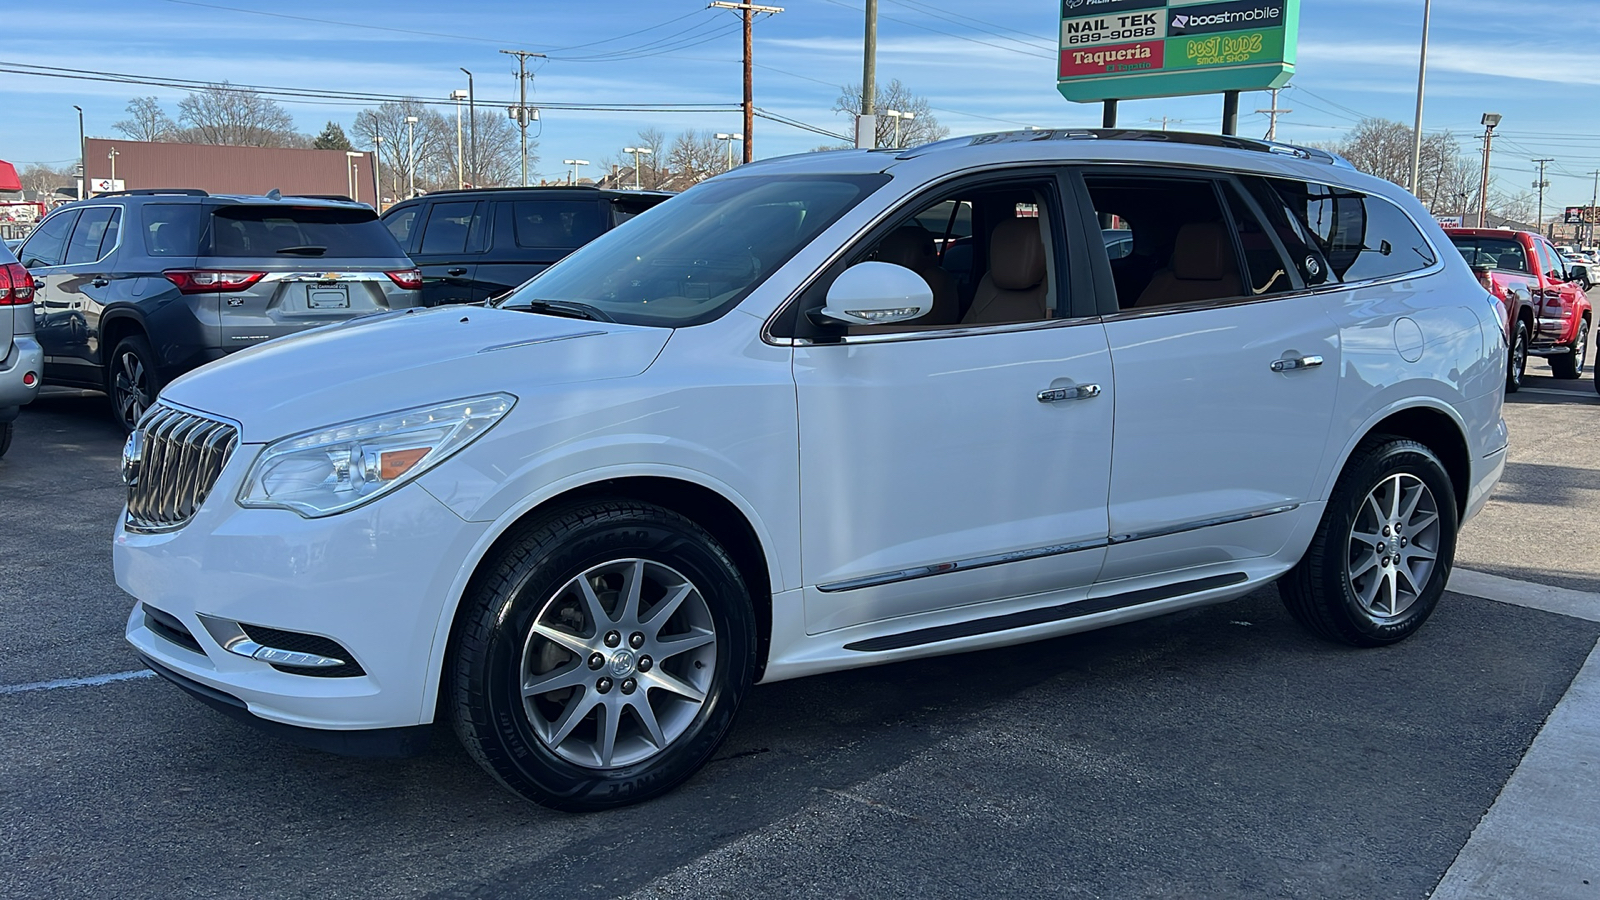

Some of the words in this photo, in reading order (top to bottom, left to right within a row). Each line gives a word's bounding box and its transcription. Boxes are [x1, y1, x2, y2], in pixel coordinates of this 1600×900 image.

[1067, 19, 1109, 34] NAIL
[1117, 12, 1157, 28] TEK
[1069, 26, 1156, 44] 689-9088
[1197, 56, 1225, 65] SMOKE
[1226, 54, 1250, 63] SHOP
